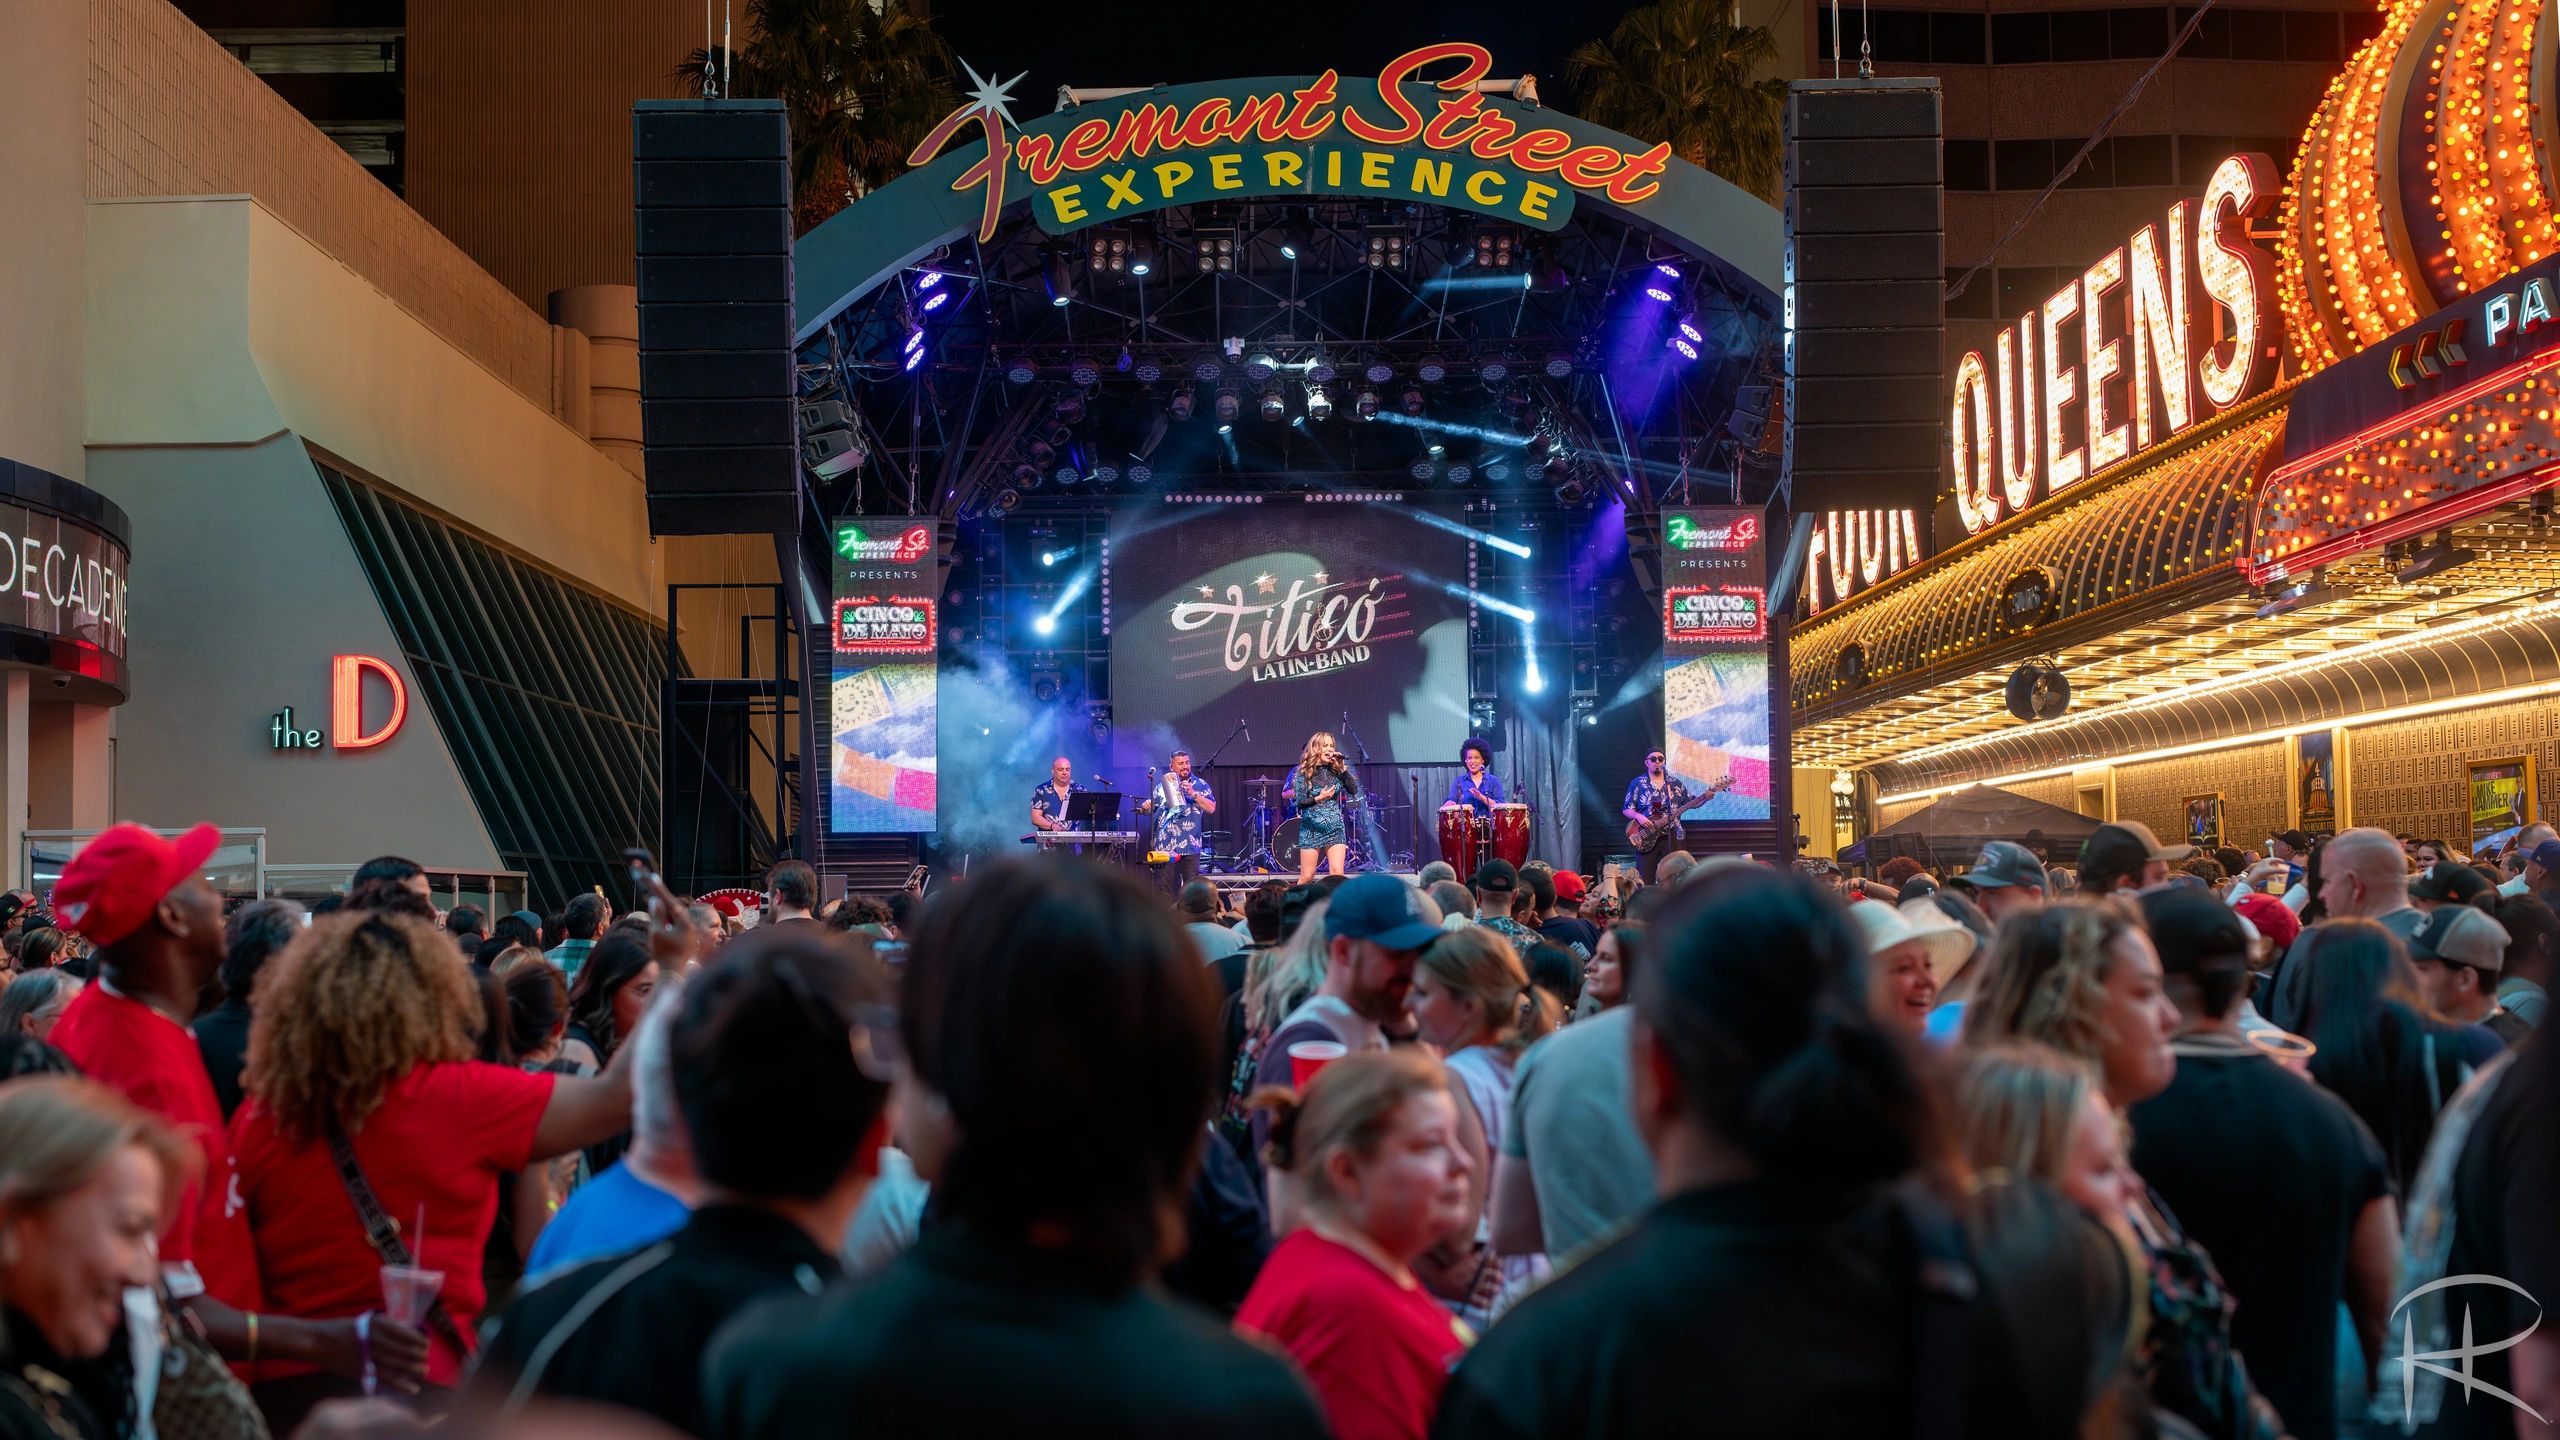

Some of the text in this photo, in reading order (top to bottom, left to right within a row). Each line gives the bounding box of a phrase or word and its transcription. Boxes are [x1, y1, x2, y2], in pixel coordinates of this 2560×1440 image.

[907, 42, 1673, 244] Fremont Street
[1048, 151, 1559, 223] EXPERIENCE
[2485, 278, 2560, 348] PA
[1951, 153, 2265, 537] QUEENS
[1668, 519, 1732, 541] Fremont
[838, 529, 903, 552] Fremont
[853, 551, 916, 559] EXPERIENCE
[1681, 560, 1747, 568] PRESENTS
[850, 571, 918, 579] PRESENTS
[1686, 595, 1744, 611] CINCO
[855, 606, 913, 622] CINCO
[1674, 612, 1757, 629] DE MAYO
[842, 623, 927, 639] DE MAYO
[1171, 578, 1386, 671] Titicó
[271, 655, 408, 749] the D
[2476, 781, 2496, 798] MIKE
